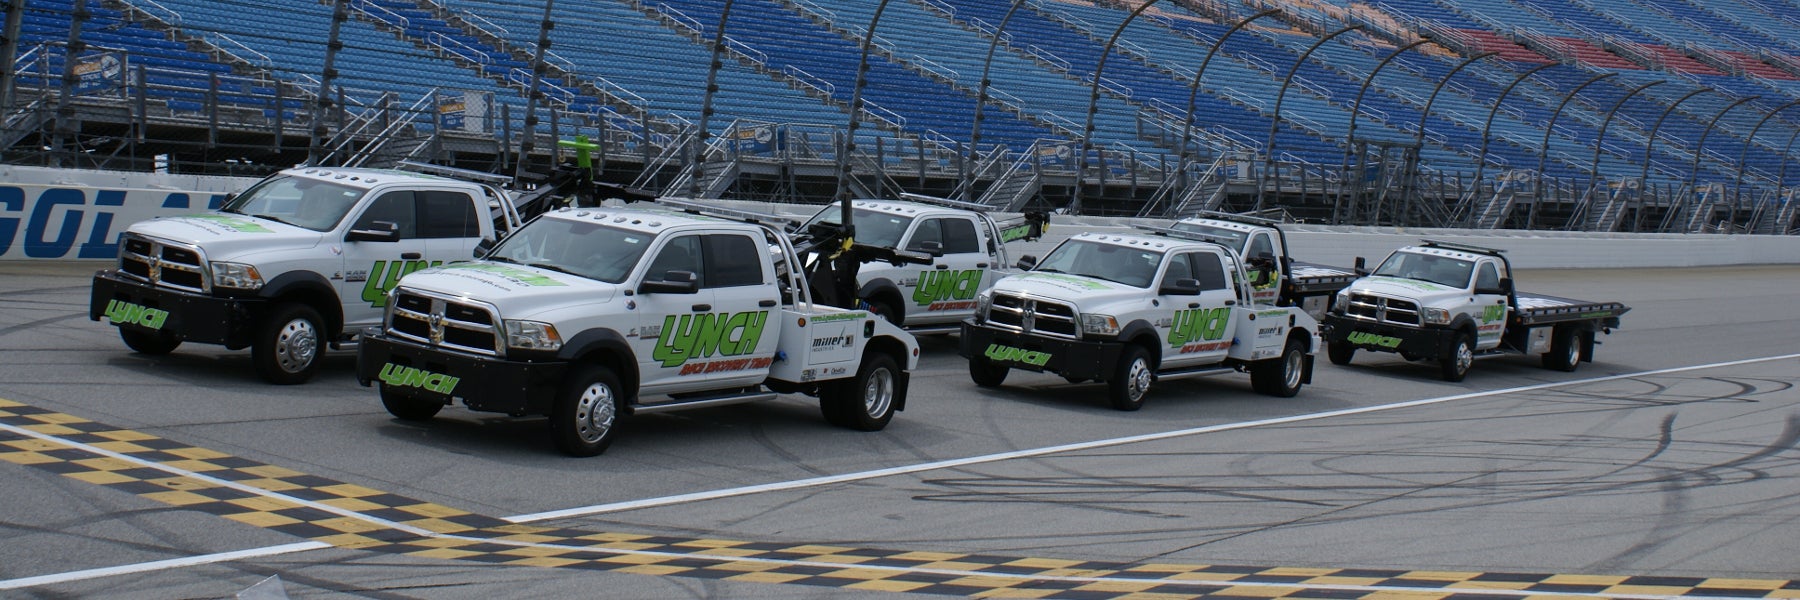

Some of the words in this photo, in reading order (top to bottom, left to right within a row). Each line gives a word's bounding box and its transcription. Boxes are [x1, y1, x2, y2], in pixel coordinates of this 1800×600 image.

[912, 269, 983, 306] LYNCH
[104, 299, 169, 330] LYNCH
[1167, 307, 1231, 347] LYNCH
[652, 310, 769, 368] LYNCH
[812, 334, 844, 347] miller
[1347, 331, 1403, 348] LYNCH
[984, 344, 1052, 366] LYNCH
[378, 363, 460, 395] LYNCH
